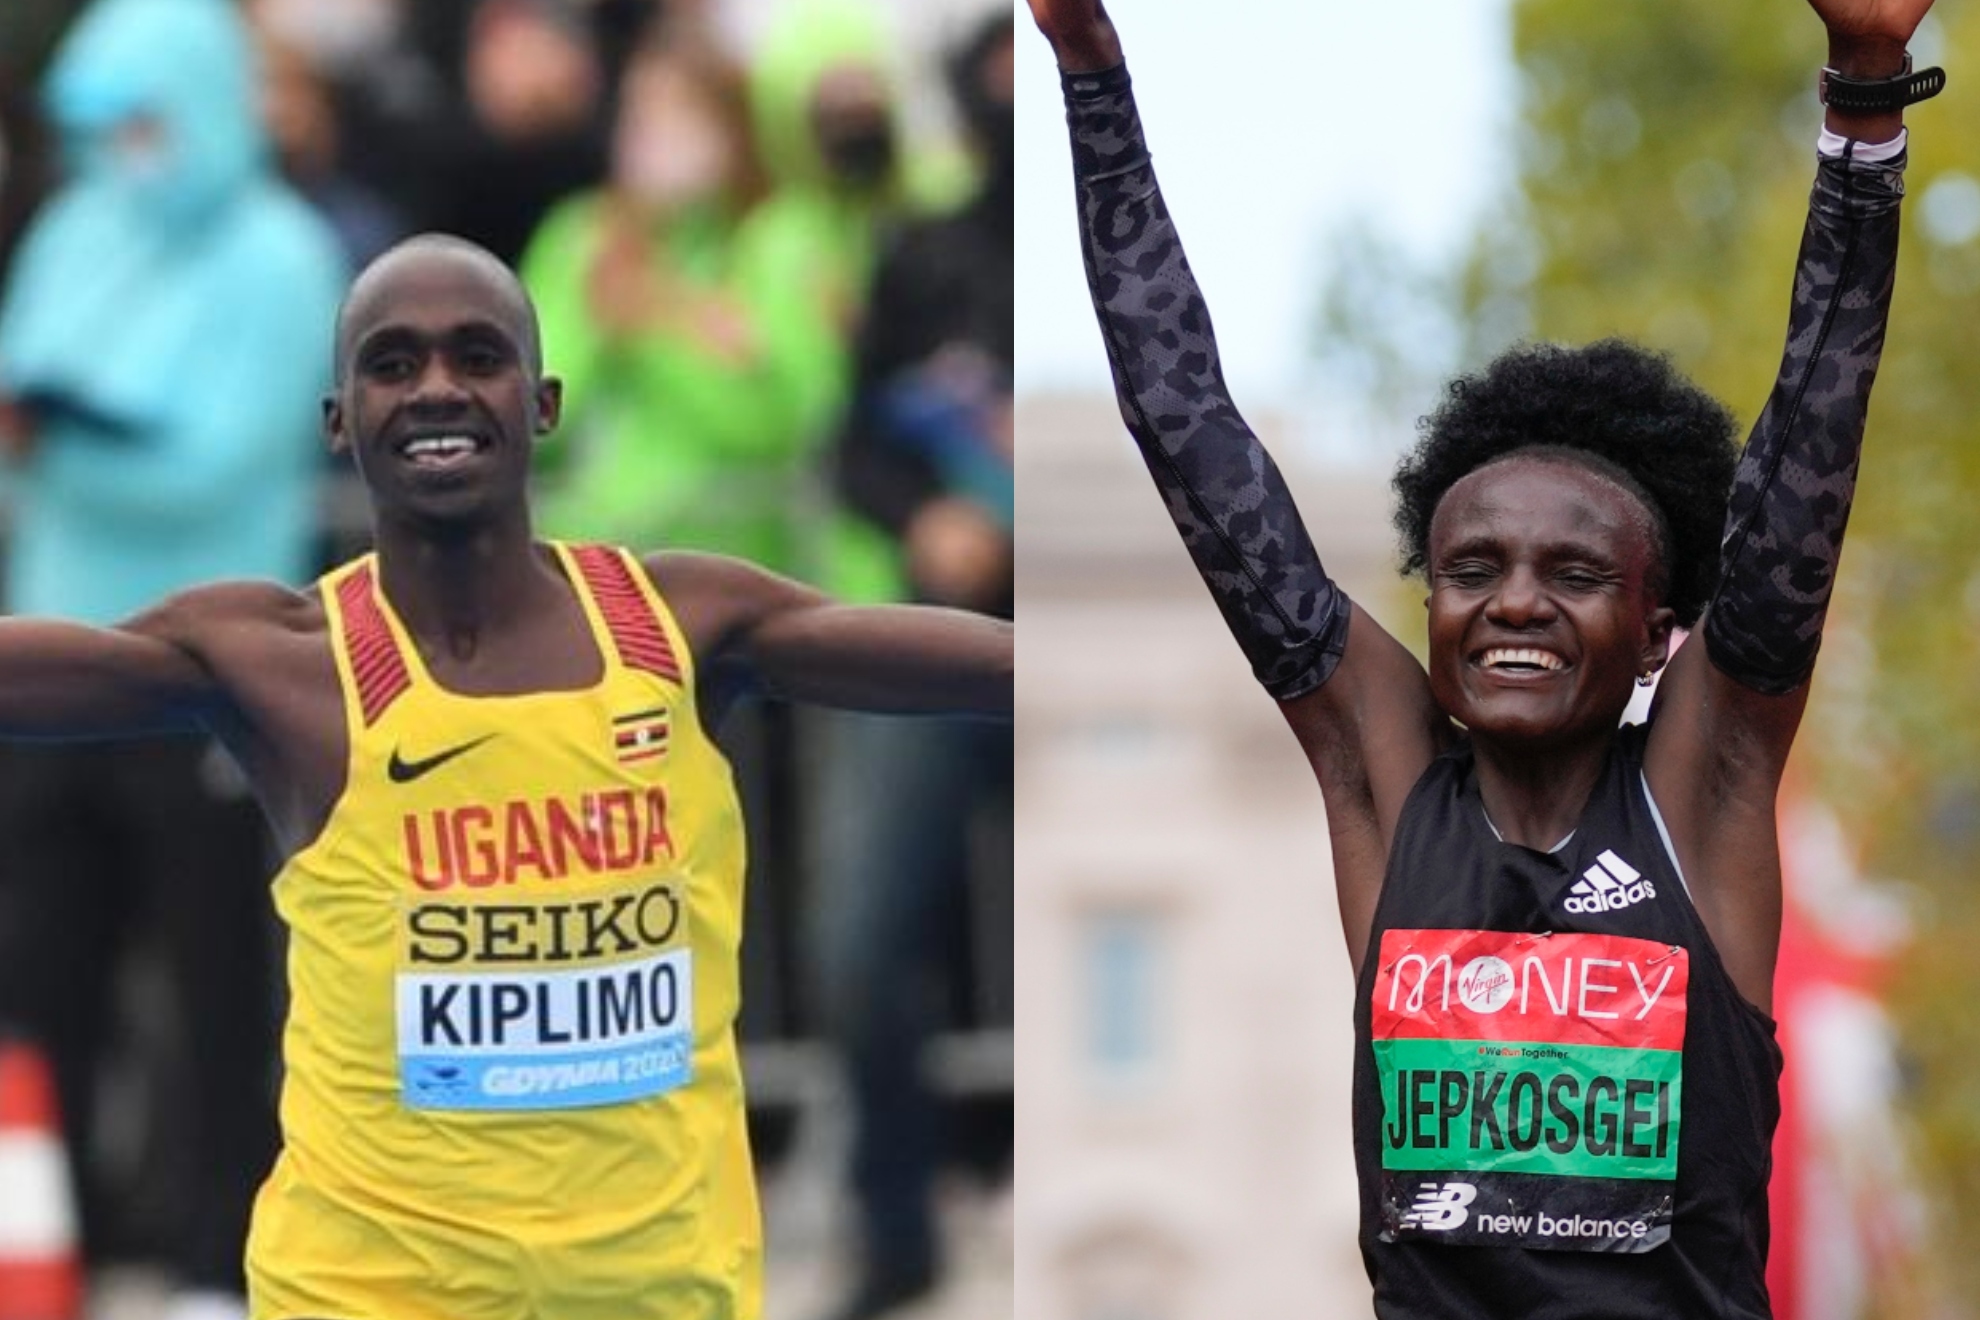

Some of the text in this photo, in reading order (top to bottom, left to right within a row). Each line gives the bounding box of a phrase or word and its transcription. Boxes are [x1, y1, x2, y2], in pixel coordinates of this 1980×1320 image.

[403, 785, 674, 891] UGANDA
[408, 886, 680, 963] SEIKO
[1563, 879, 1656, 914] adidas
[420, 961, 677, 1047] KIPLIMO
[1462, 963, 1510, 1005] Virgin
[480, 1058, 621, 1096] GDYNIA
[1387, 1069, 1670, 1159] JEPKOSGEI
[1477, 1213, 1648, 1239] new balance
